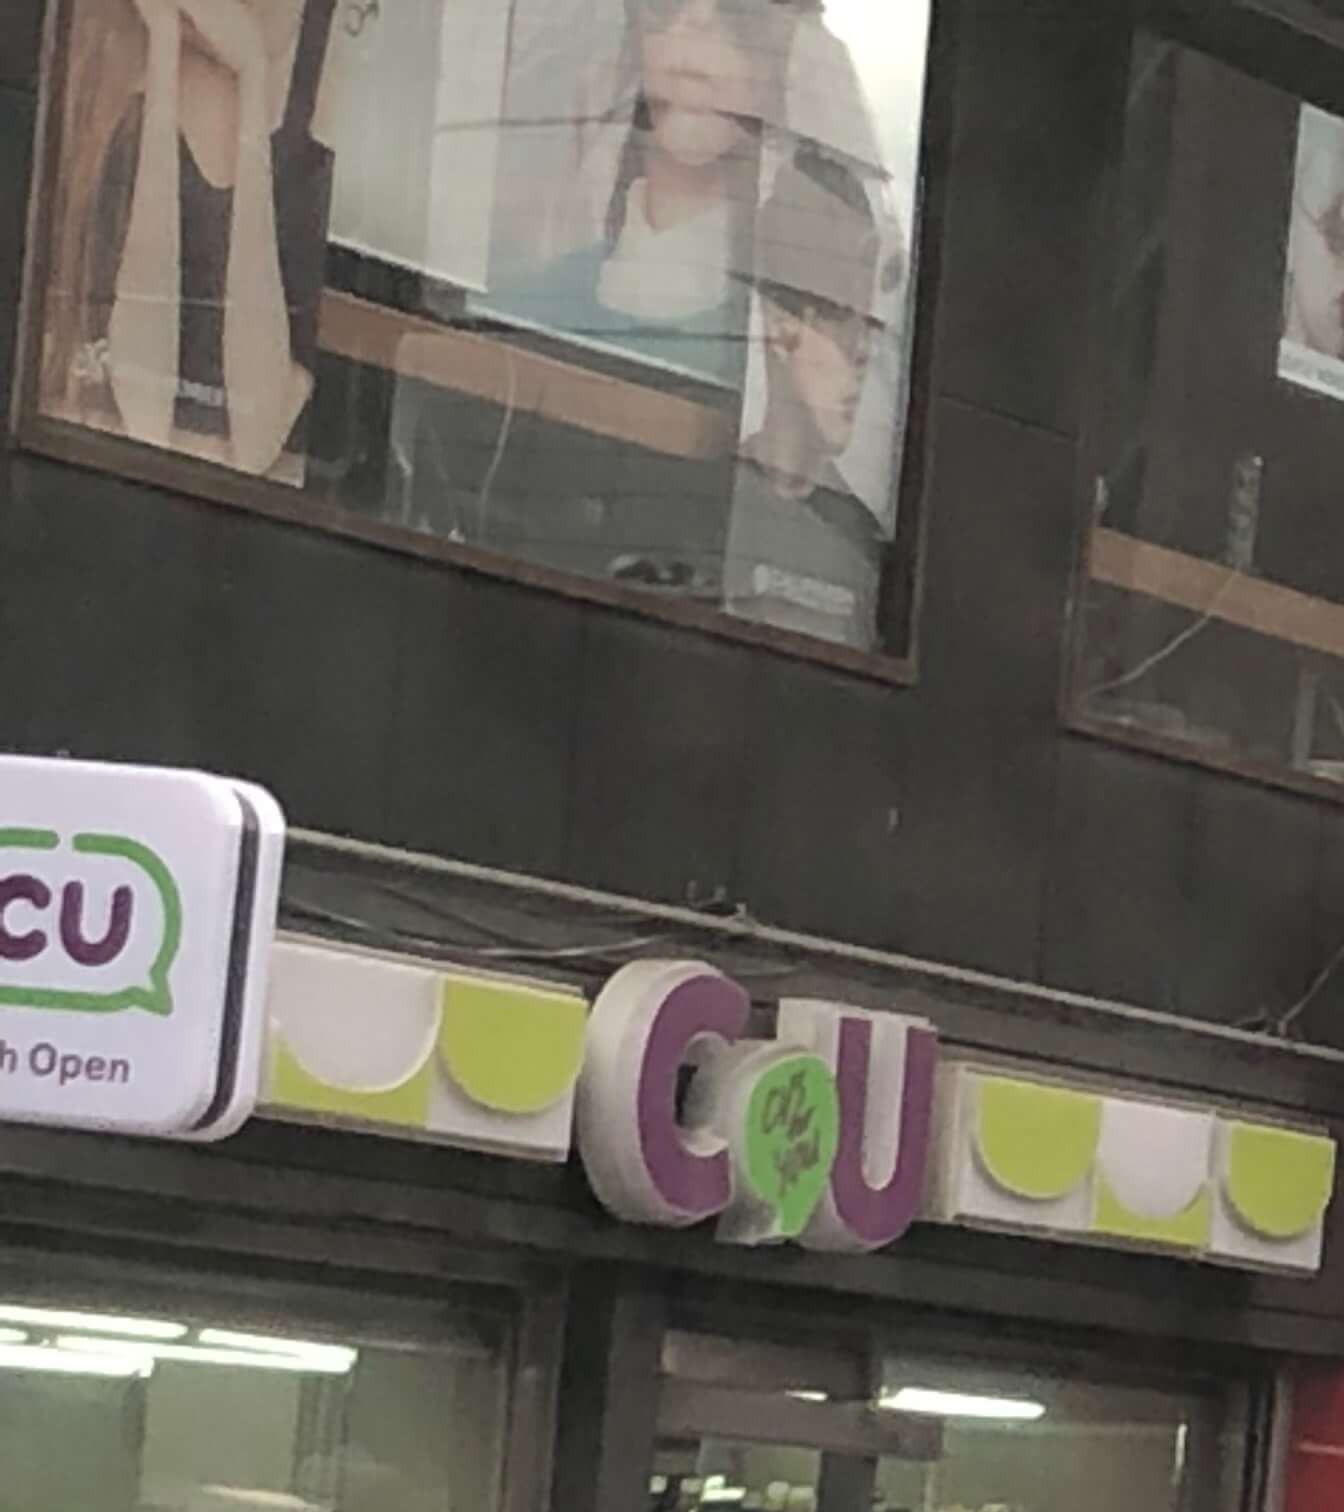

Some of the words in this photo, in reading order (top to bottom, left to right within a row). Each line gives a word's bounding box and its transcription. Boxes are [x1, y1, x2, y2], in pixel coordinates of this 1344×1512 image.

[0, 873, 133, 967] CU
[28, 1042, 130, 1086] Open
[637, 973, 939, 1243] CU
